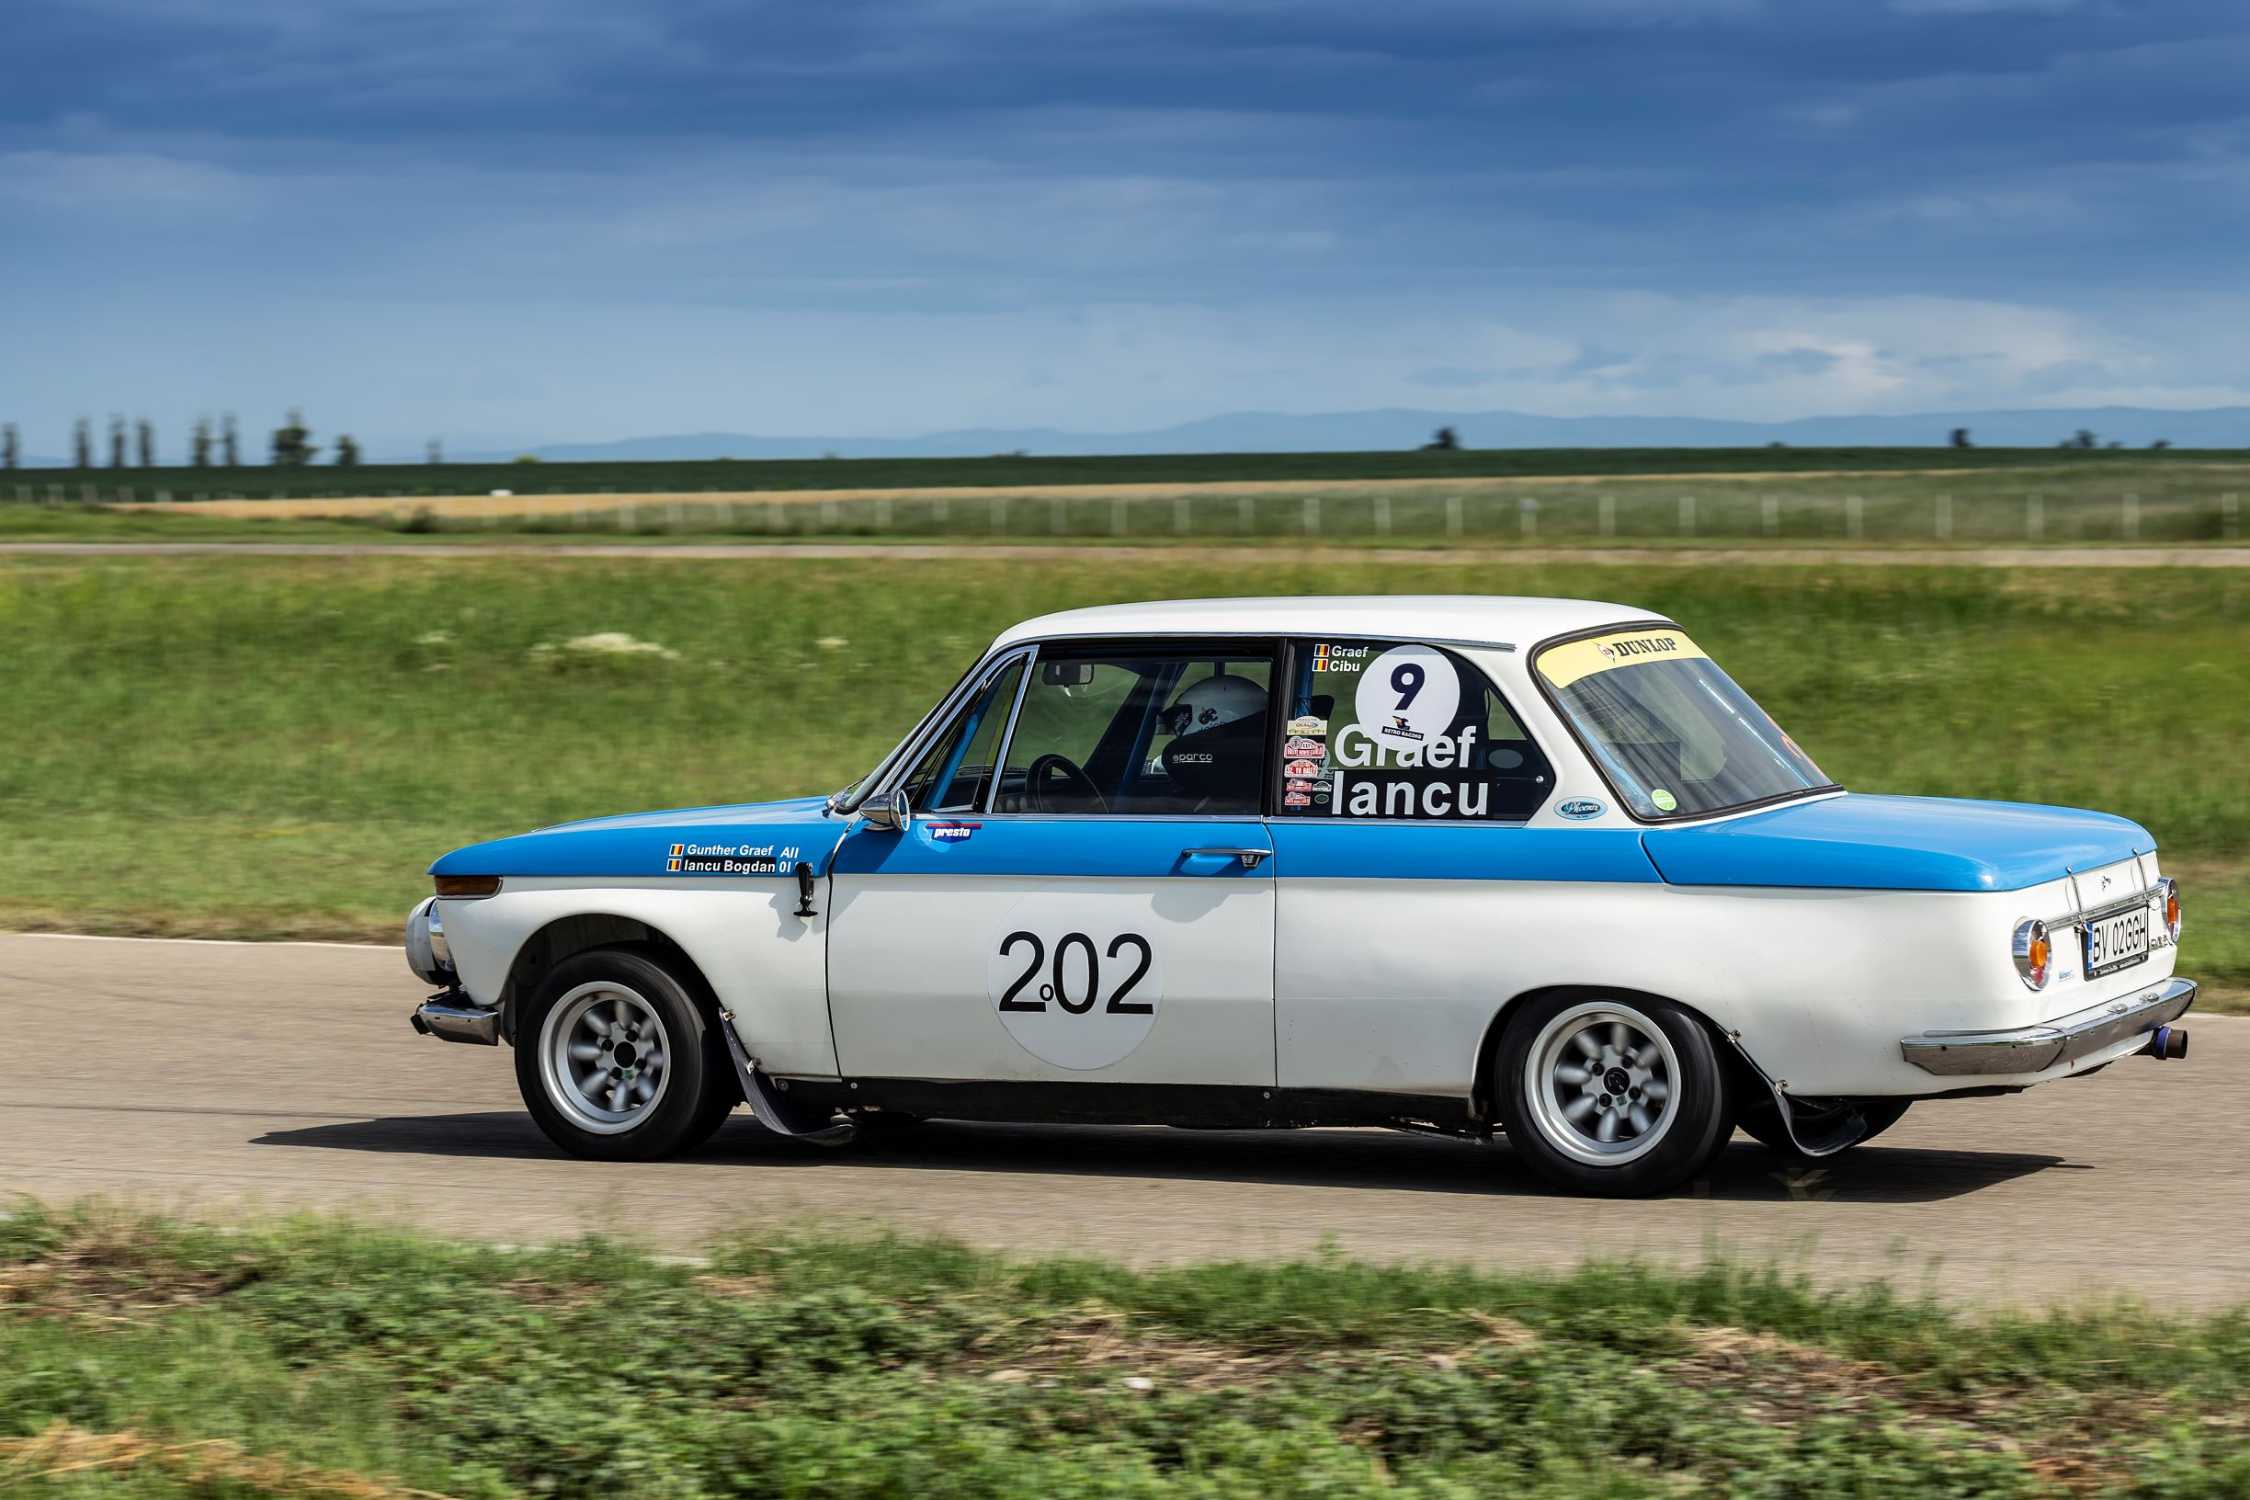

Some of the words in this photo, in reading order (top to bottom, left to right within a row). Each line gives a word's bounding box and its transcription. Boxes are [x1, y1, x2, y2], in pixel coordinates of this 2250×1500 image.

[1331, 646, 1368, 658] Graef
[1612, 637, 1677, 656] DUNLOP
[1329, 660, 1361, 672] Cibu
[1391, 663, 1425, 710] 9
[1335, 724, 1477, 768] Graef
[1172, 753, 1214, 763] sparco
[1332, 770, 1489, 815] Iancu
[934, 828, 970, 838] presto
[687, 844, 736, 856] Gunther
[739, 844, 775, 856] Graef
[684, 859, 721, 872] Iancu
[723, 860, 776, 874] Bogdan
[2093, 924, 2109, 962] BV
